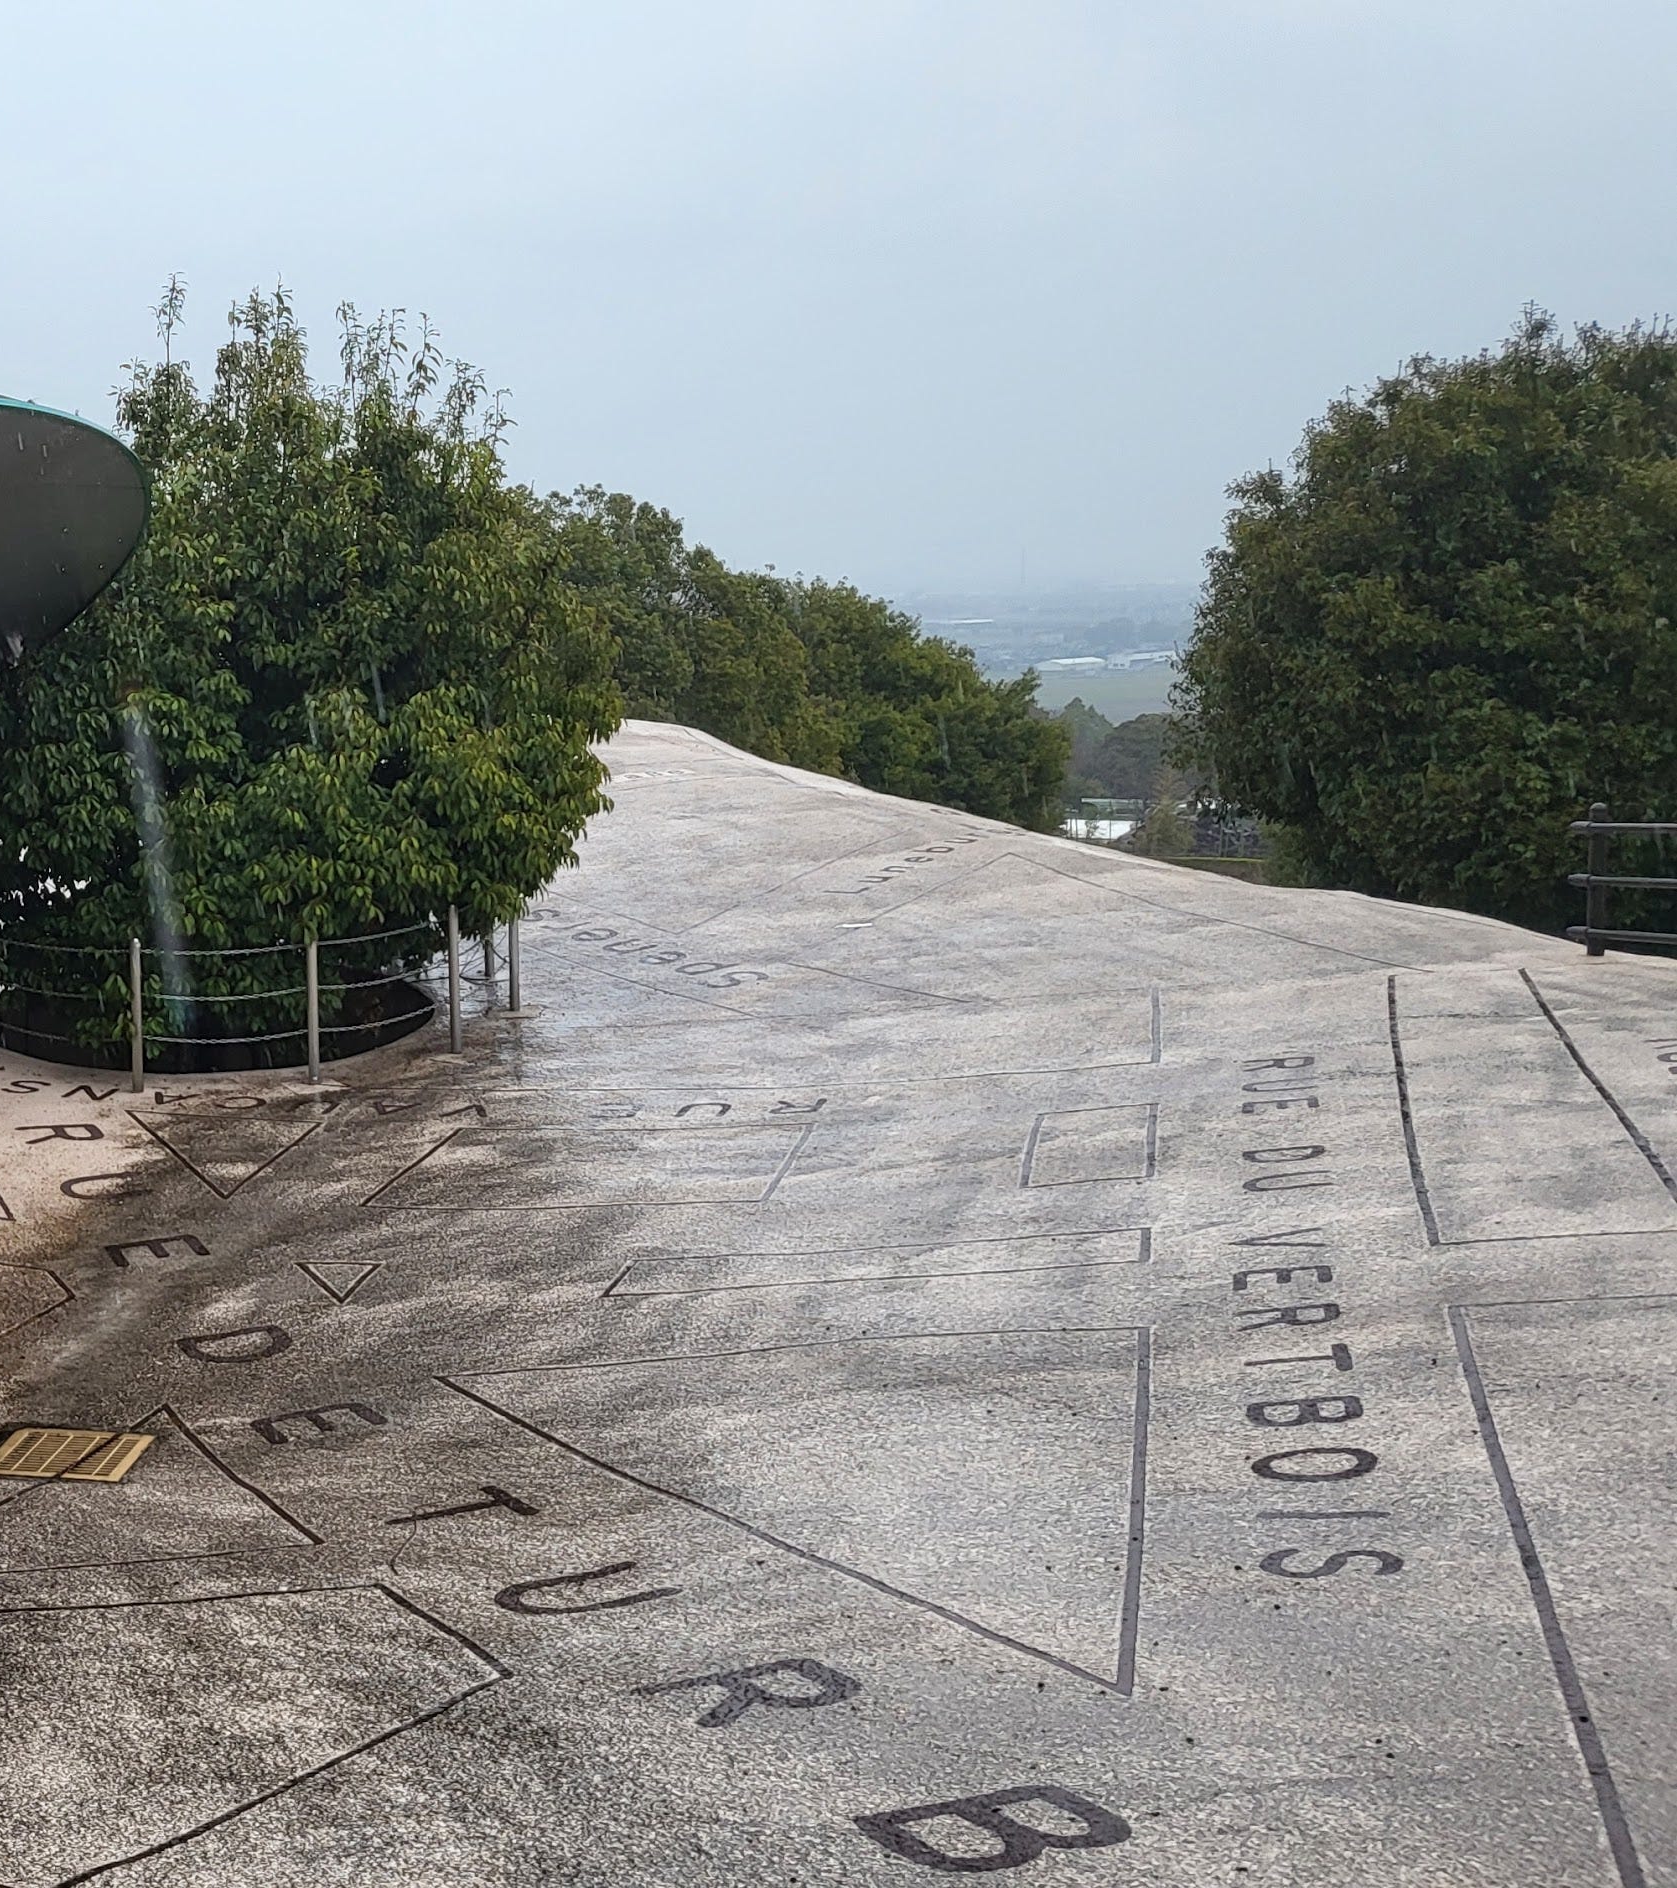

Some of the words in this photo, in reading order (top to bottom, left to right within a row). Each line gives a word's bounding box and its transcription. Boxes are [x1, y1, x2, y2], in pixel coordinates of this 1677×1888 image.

[587, 1098, 828, 1119] RUE
[1242, 1055, 1320, 1114] RUE
[1242, 1144, 1334, 1192] DU
[14, 1122, 211, 1267] RUE
[174, 1323, 389, 1445] DE
[1229, 1226, 1404, 1579] VERTBOIS
